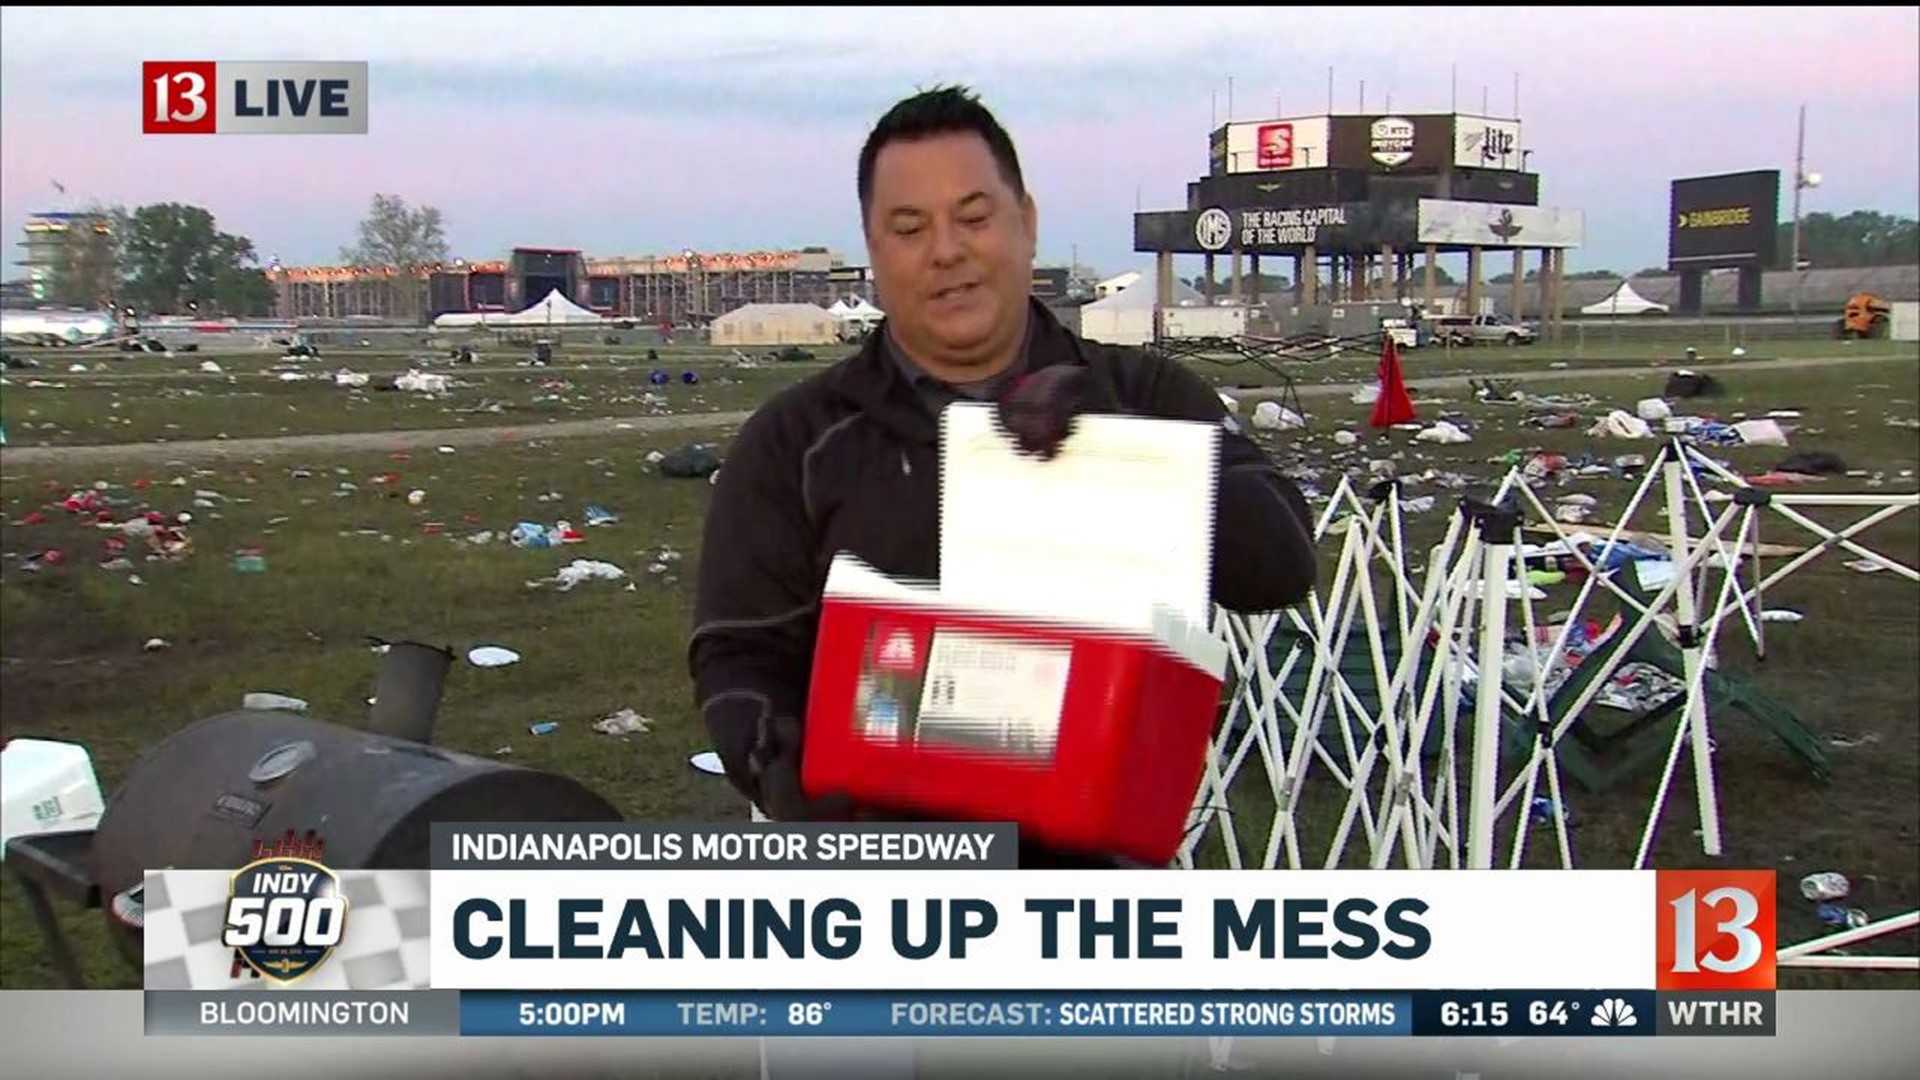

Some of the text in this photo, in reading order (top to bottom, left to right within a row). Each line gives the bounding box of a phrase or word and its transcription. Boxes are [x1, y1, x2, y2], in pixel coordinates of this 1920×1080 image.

[1482, 127, 1514, 160] Lite
[1242, 207, 1347, 227] THE RACING CAPITAL
[1242, 226, 1316, 245] OF THE WORLD
